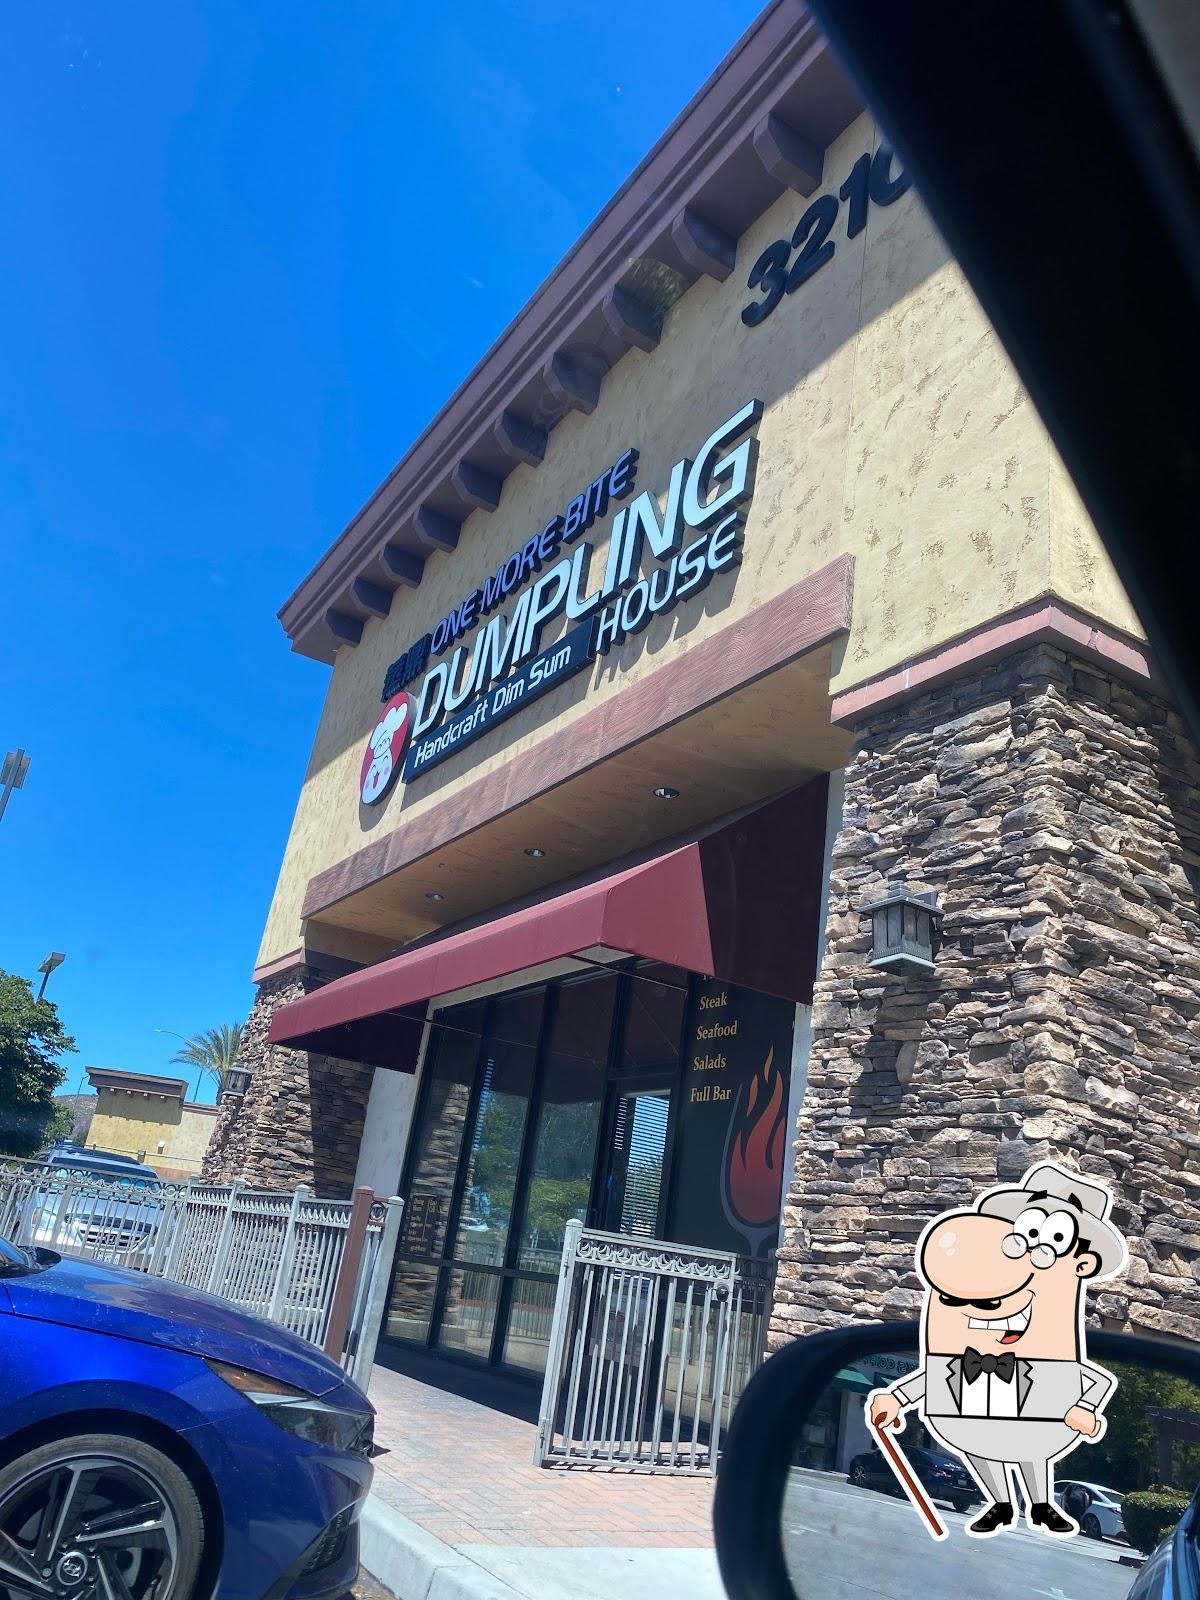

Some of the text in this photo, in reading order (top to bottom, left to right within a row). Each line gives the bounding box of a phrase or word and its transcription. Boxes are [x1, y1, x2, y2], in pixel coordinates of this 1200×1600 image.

[411, 399, 764, 740] DUMPLING
[431, 448, 639, 656] ONE MORE BITE
[597, 512, 745, 655] HOUSE
[414, 644, 572, 768] Handcraft Dim Sum
[696, 1020, 738, 1040] Seafood
[699, 991, 728, 1010] Steak
[690, 1085, 732, 1102] Full Bar
[693, 1053, 727, 1071] Salads
